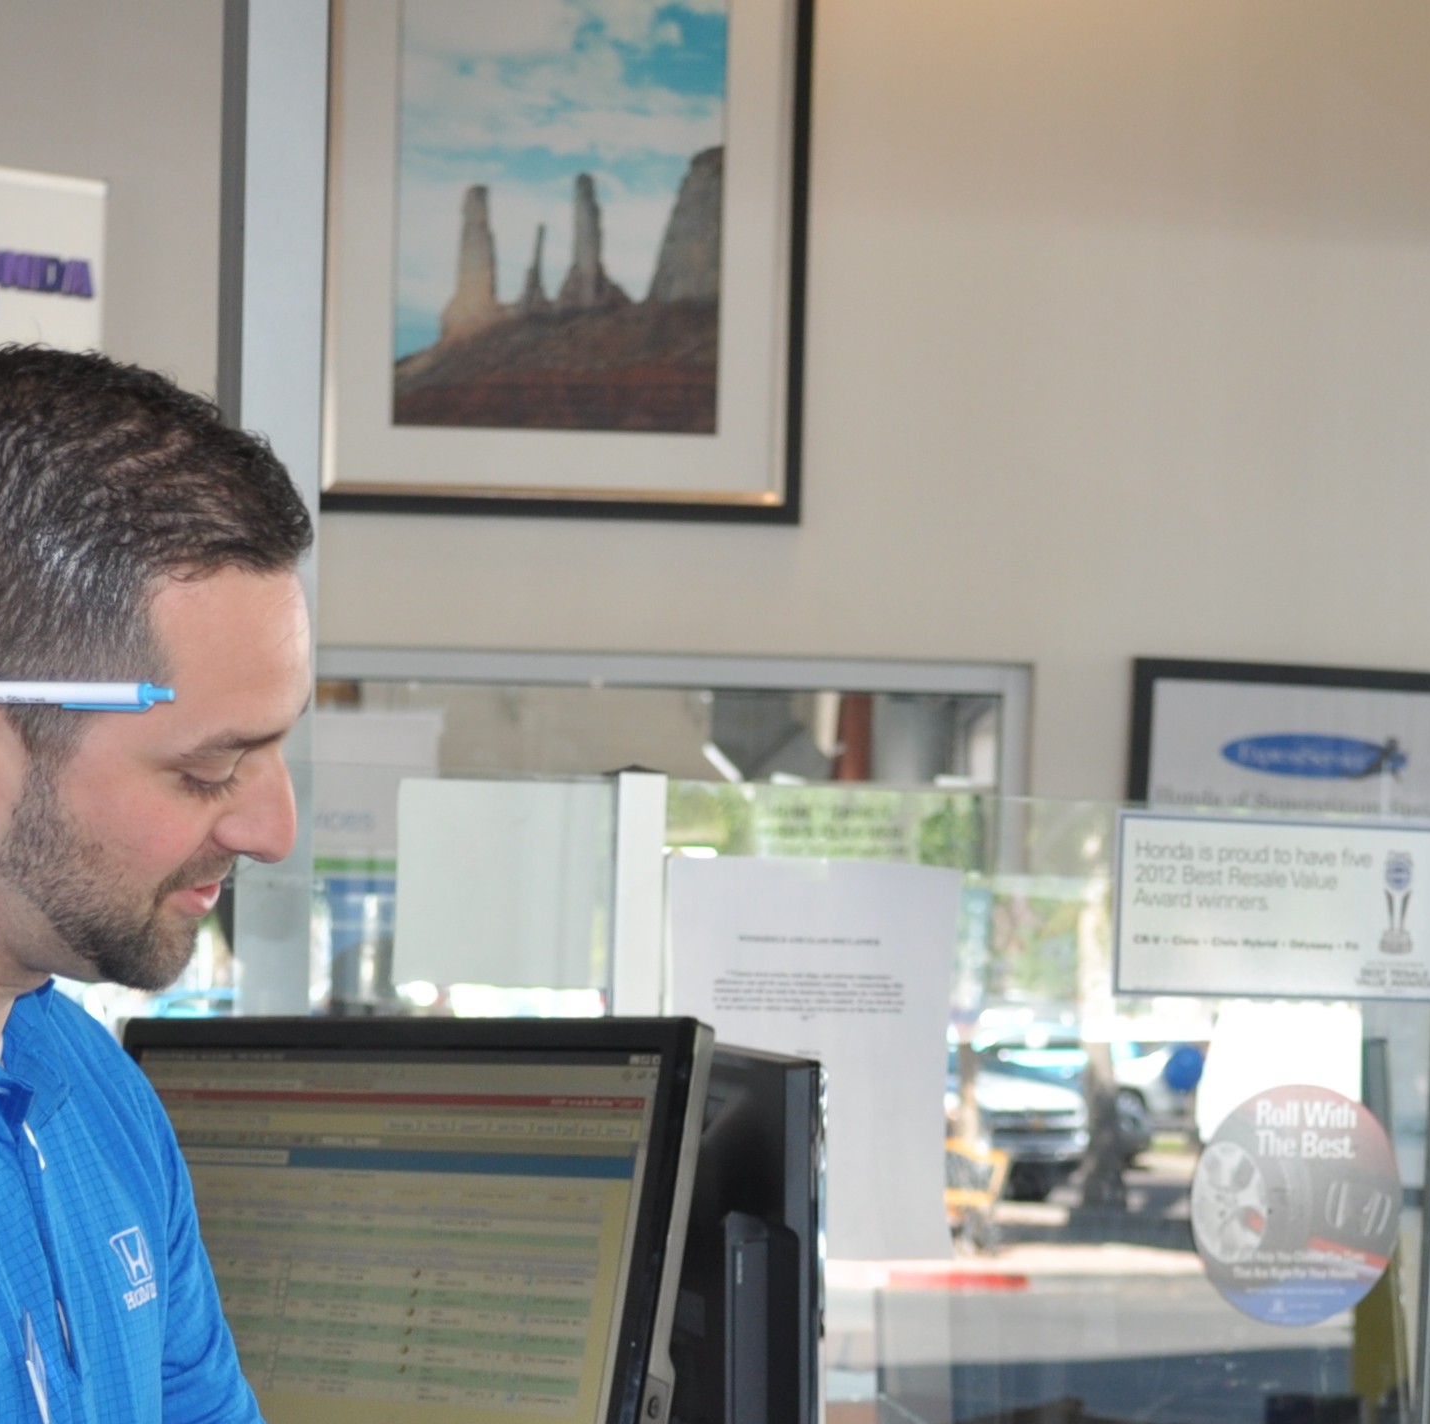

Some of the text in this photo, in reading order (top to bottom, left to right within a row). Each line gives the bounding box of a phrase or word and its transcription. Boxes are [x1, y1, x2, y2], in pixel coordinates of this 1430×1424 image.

[1134, 841, 1374, 869] Honda is proud to have five
[1135, 864, 1339, 891] 2012 Best Resale Value
[1133, 888, 1192, 909] Award
[1256, 1100, 1357, 1129] Roll With
[1254, 1129, 1297, 1158] The
